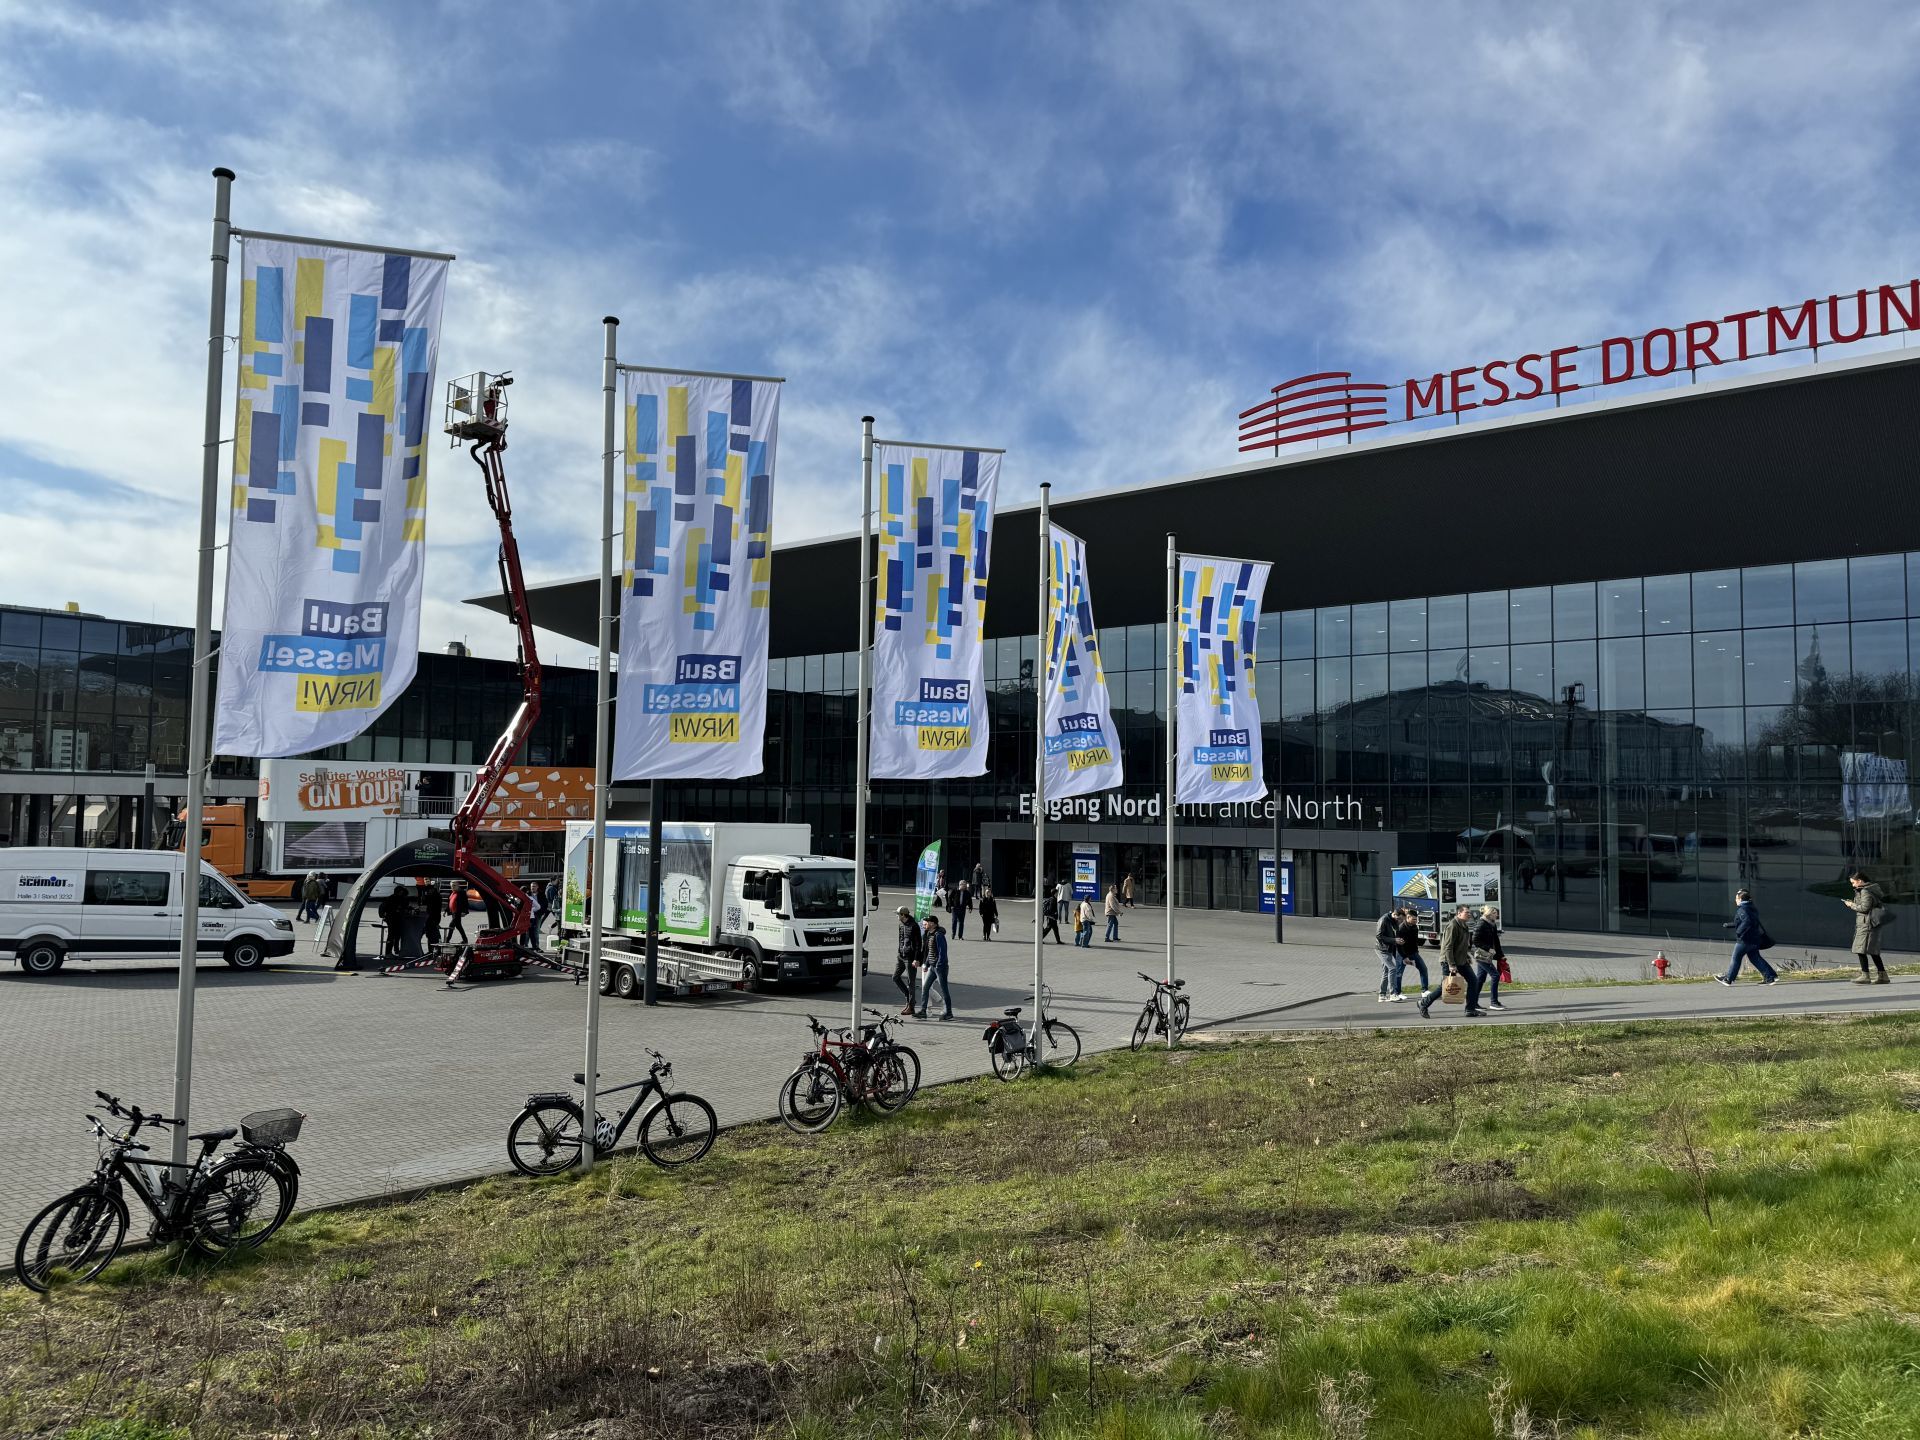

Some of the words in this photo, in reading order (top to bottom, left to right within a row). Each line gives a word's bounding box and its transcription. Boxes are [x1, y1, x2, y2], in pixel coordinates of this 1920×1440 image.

[1406, 345, 1581, 421] MESSE
[308, 782, 341, 808] ON
[346, 780, 402, 805] TOUR
[1108, 793, 1161, 817] Nord
[1174, 799, 1276, 819] ntrance
[1286, 794, 1362, 820] North
